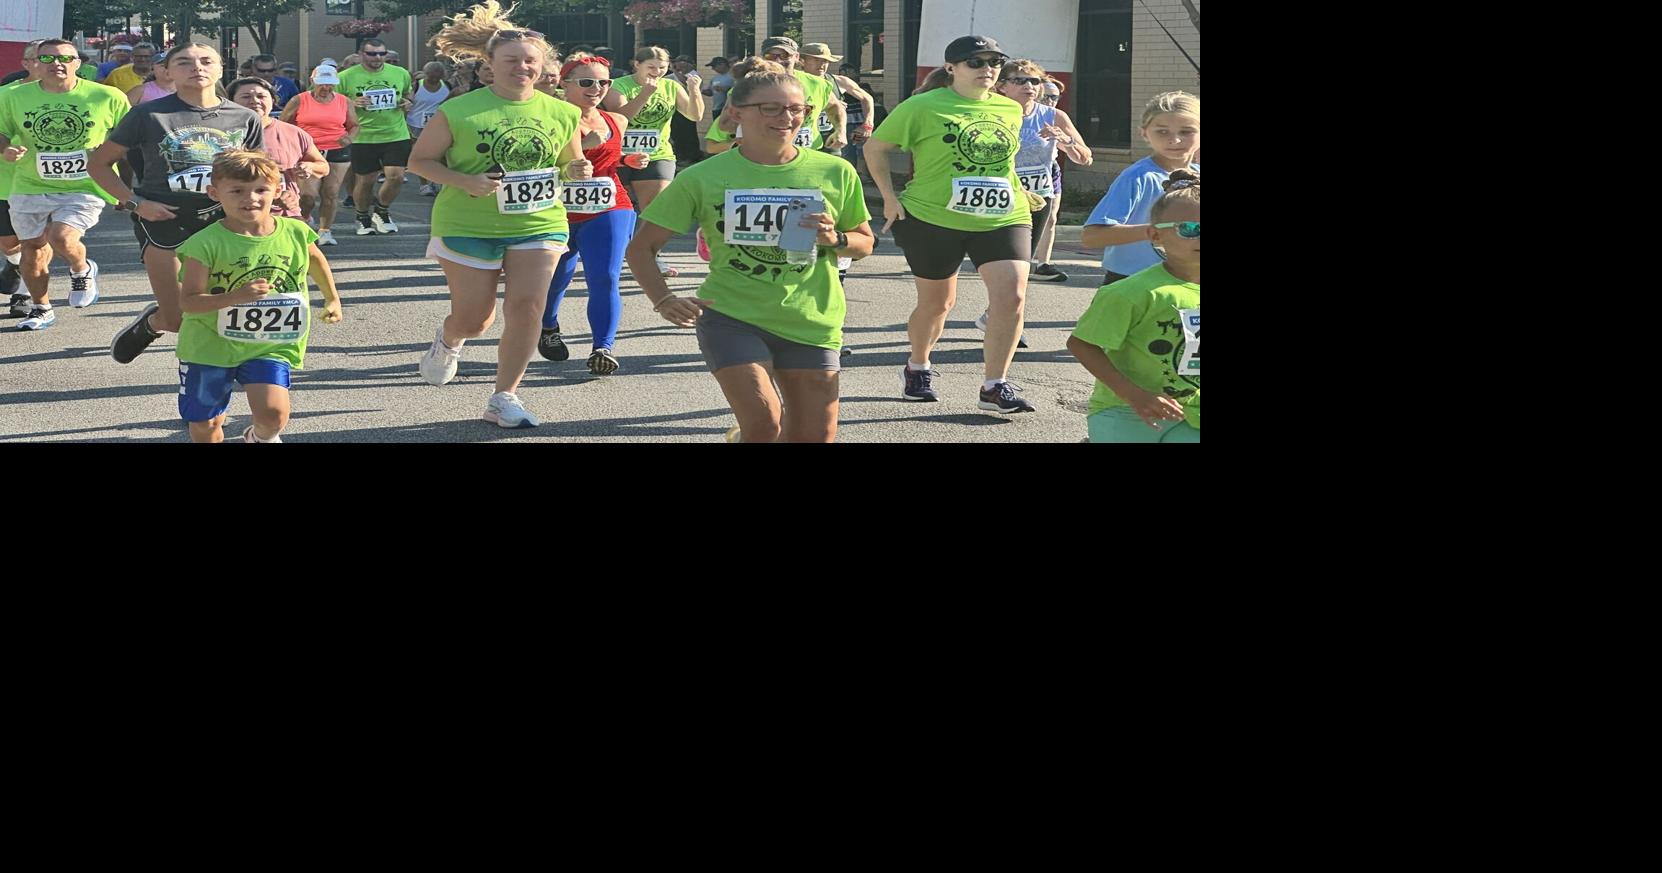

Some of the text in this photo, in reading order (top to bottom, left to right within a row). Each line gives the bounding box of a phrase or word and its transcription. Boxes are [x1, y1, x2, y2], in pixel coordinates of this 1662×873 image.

[371, 94, 394, 105] 747
[622, 136, 657, 148] 1740
[41, 159, 87, 174] 1822
[1019, 174, 1050, 191] 872
[503, 180, 555, 204] 1823
[562, 187, 612, 205] 1849
[956, 187, 1010, 208] 1869
[734, 204, 788, 232] 140
[225, 307, 302, 331] 1824
